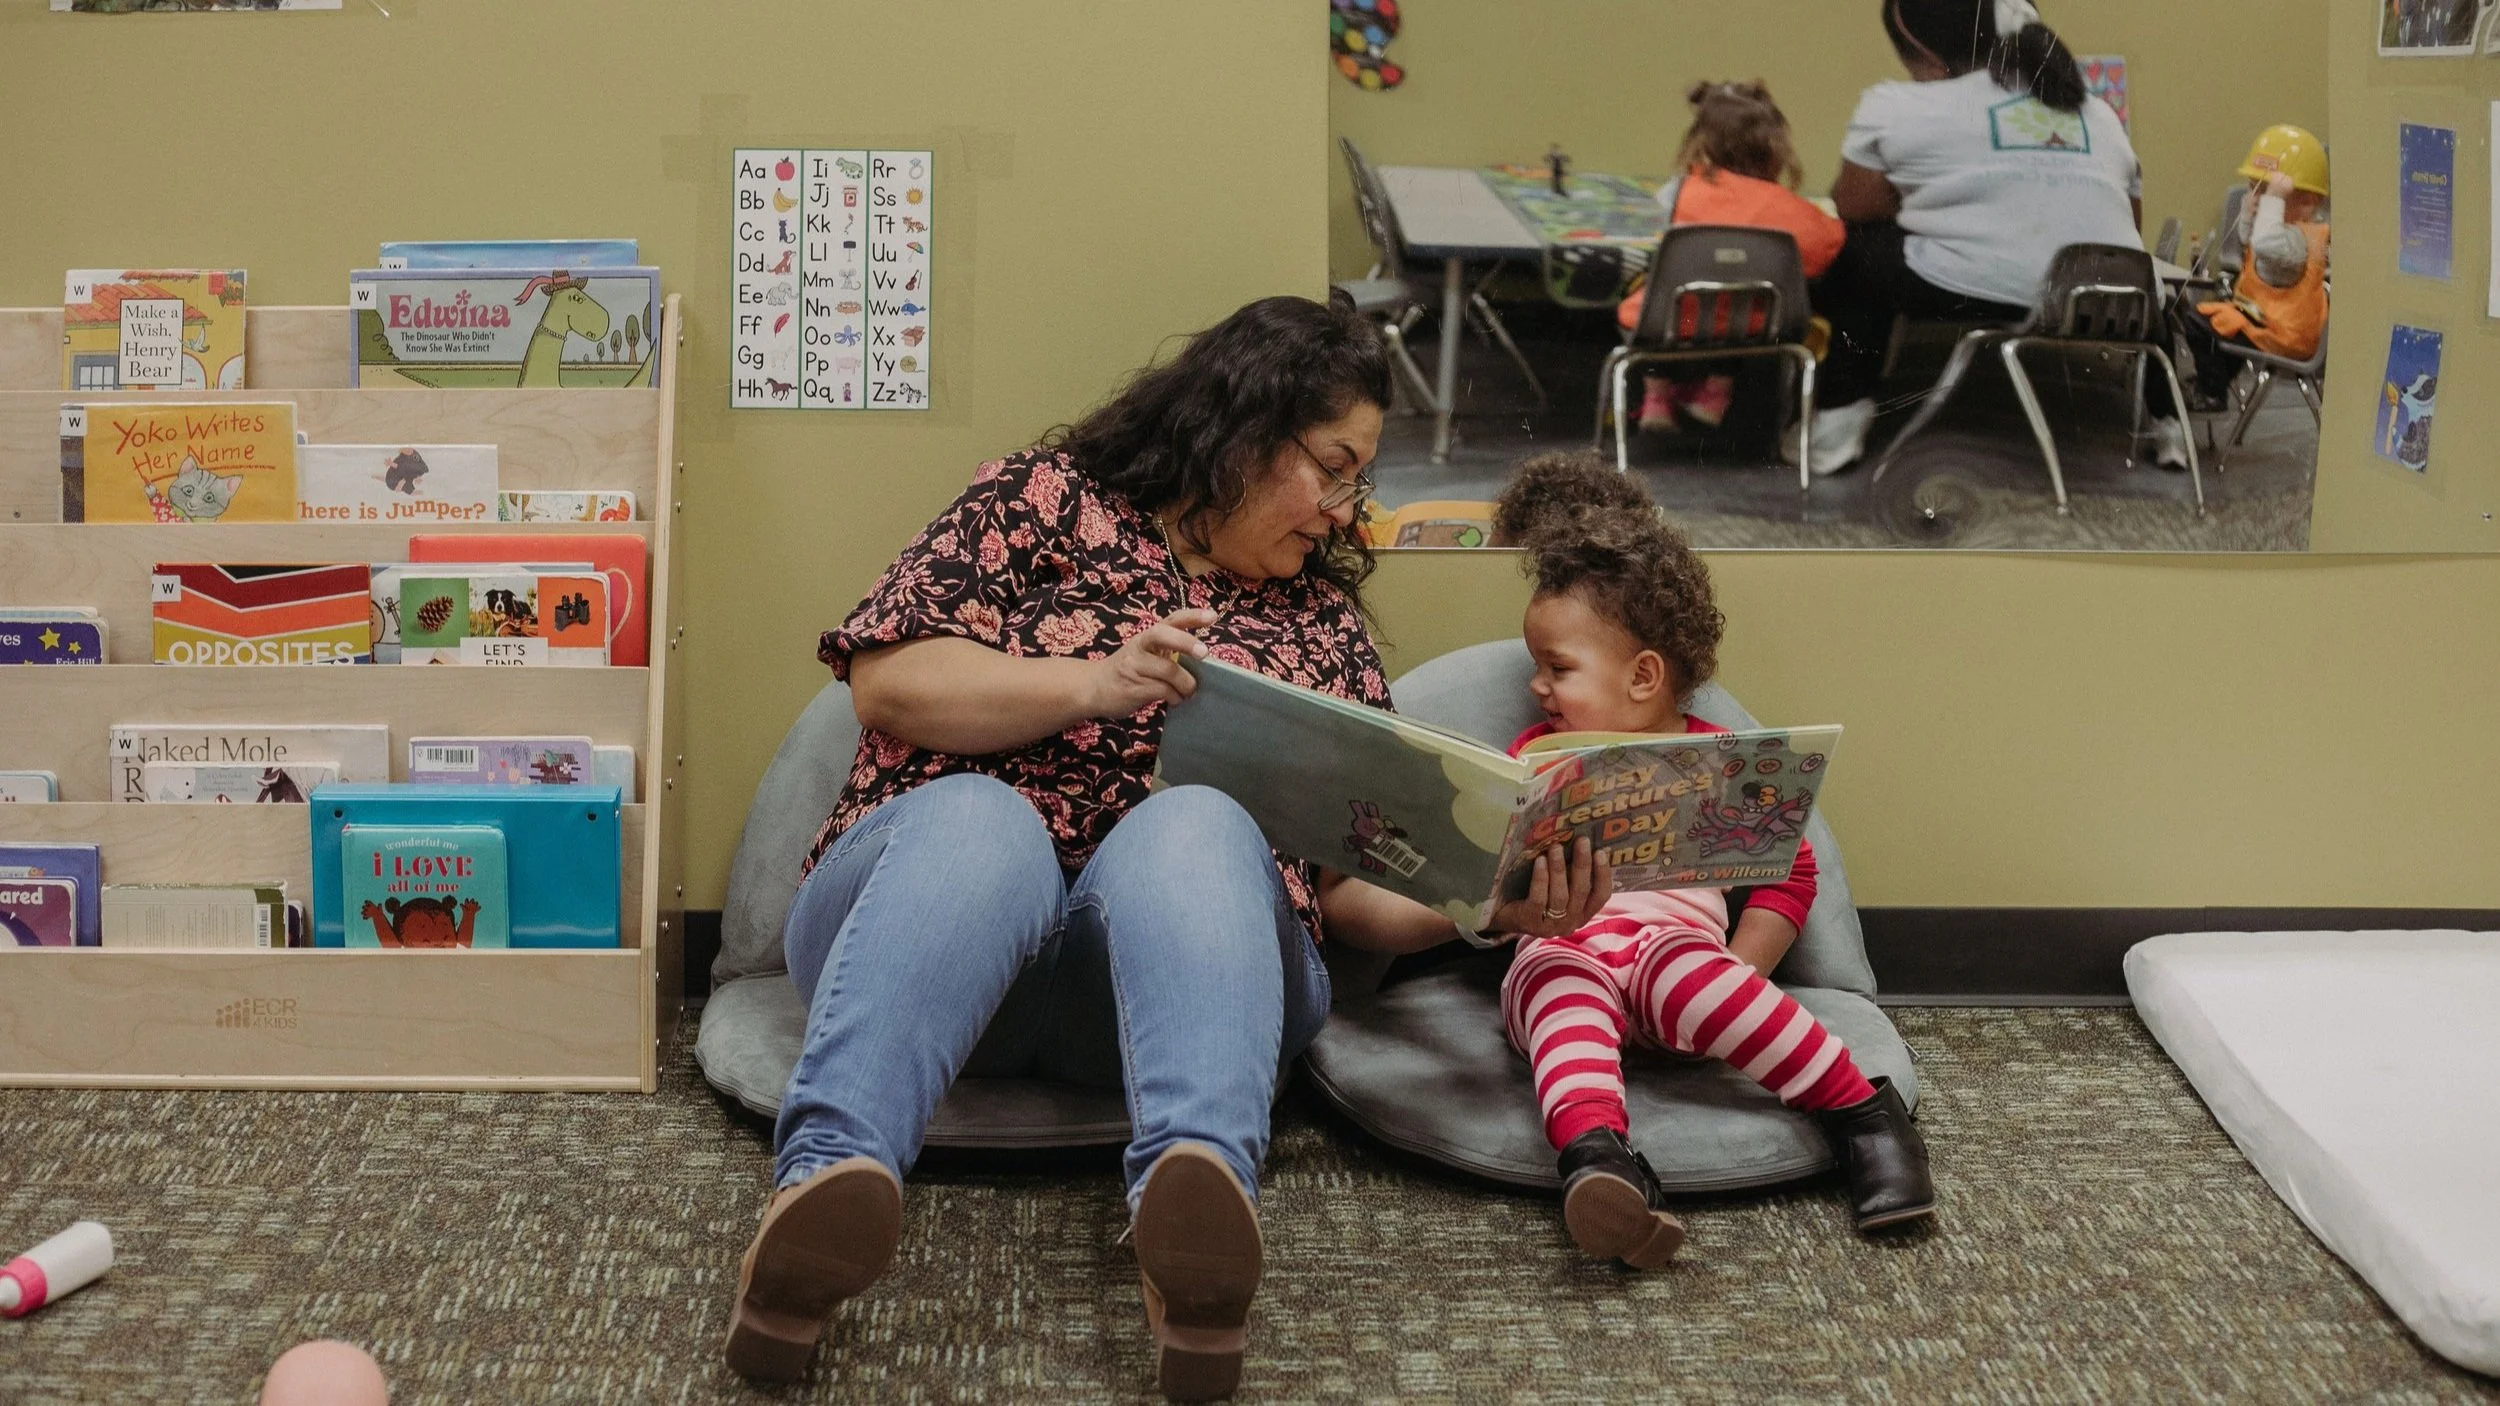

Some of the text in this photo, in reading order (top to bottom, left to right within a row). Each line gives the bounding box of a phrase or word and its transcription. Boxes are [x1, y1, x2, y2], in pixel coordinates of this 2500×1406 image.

[739, 160, 766, 179] Aa
[873, 159, 896, 178] Rr
[740, 190, 765, 210] Bb
[810, 183, 829, 208] Jj
[874, 186, 896, 206] Ss
[739, 222, 765, 241] Cc
[807, 214, 831, 233] Kk
[875, 214, 895, 234] Tt
[872, 242, 896, 262] Uu
[739, 253, 764, 272] Dd
[803, 271, 834, 288] Mm
[873, 270, 896, 289] Vv
[74, 285, 85, 296] W
[357, 290, 369, 301] W
[739, 284, 763, 304] Ee
[124, 304, 178, 319] Make a
[388, 289, 511, 329] Edwina
[805, 298, 830, 317] Nn
[868, 300, 900, 316] Ww
[740, 315, 762, 335] Ff
[401, 331, 495, 341] The Dinosaur Who Didn't
[804, 326, 831, 345] Oo
[873, 326, 895, 346] Xx
[124, 341, 177, 361] Henry
[406, 342, 490, 353] Know She Was Extinct
[738, 345, 764, 370] Gg
[806, 352, 829, 376] Pp
[873, 352, 895, 377] Yy
[129, 361, 172, 378] Bear
[738, 379, 763, 398] Hh
[804, 378, 834, 404] Qq
[872, 382, 896, 402] Zz
[69, 417, 81, 428] W
[113, 410, 265, 455] Yoko Writes
[132, 444, 255, 478] Her Name
[298, 500, 486, 519] here is Jumper?
[162, 583, 174, 594] W
[168, 640, 355, 666] OPPOSITES
[483, 644, 525, 656] LET'S
[119, 738, 131, 750] W
[220, 737, 288, 762] Mole
[1566, 764, 1660, 806] Busy
[1516, 795, 1528, 806] W
[1530, 772, 1714, 840] Creature's
[1602, 807, 1676, 841] Day
[385, 838, 459, 851] wonderful me
[394, 856, 473, 877] LOVE
[1713, 865, 1787, 880] Willems
[387, 880, 460, 893] all of me
[253, 998, 297, 1016] ECR
